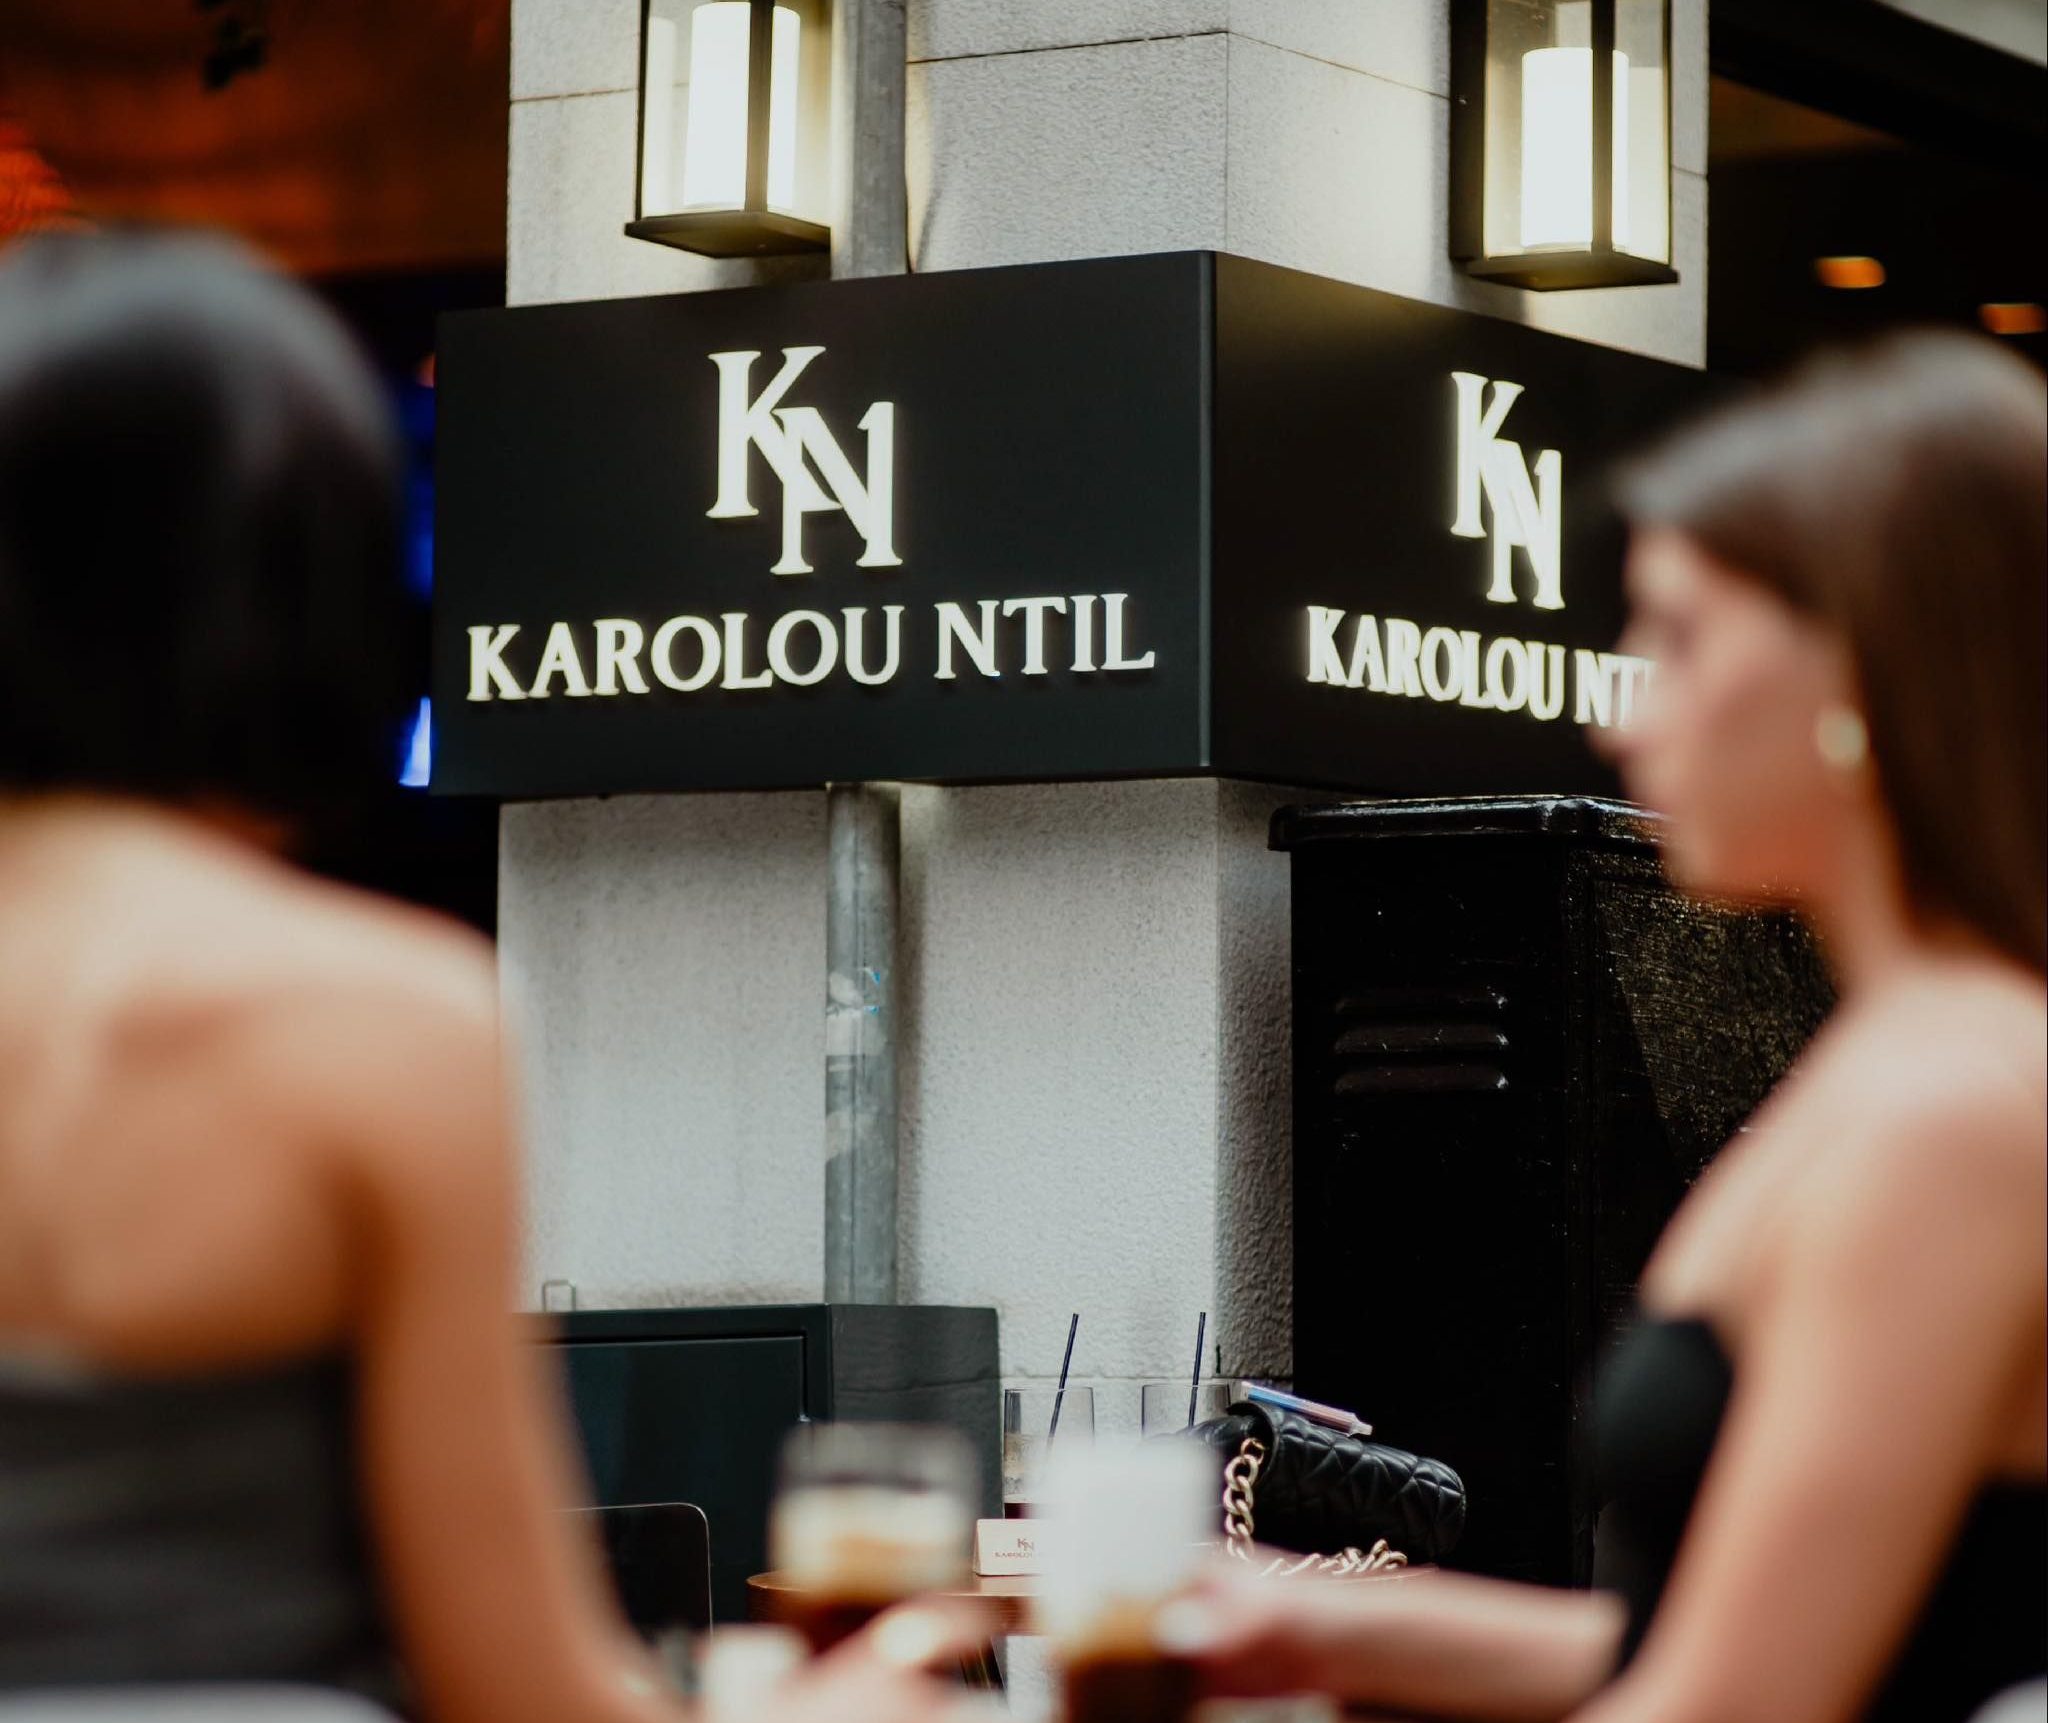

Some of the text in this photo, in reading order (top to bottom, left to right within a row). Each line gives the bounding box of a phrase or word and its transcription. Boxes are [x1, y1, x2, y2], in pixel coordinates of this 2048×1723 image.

[466, 593, 1156, 701] KAROLOU NTIL
[1306, 605, 1658, 730] KAROLOU NT
